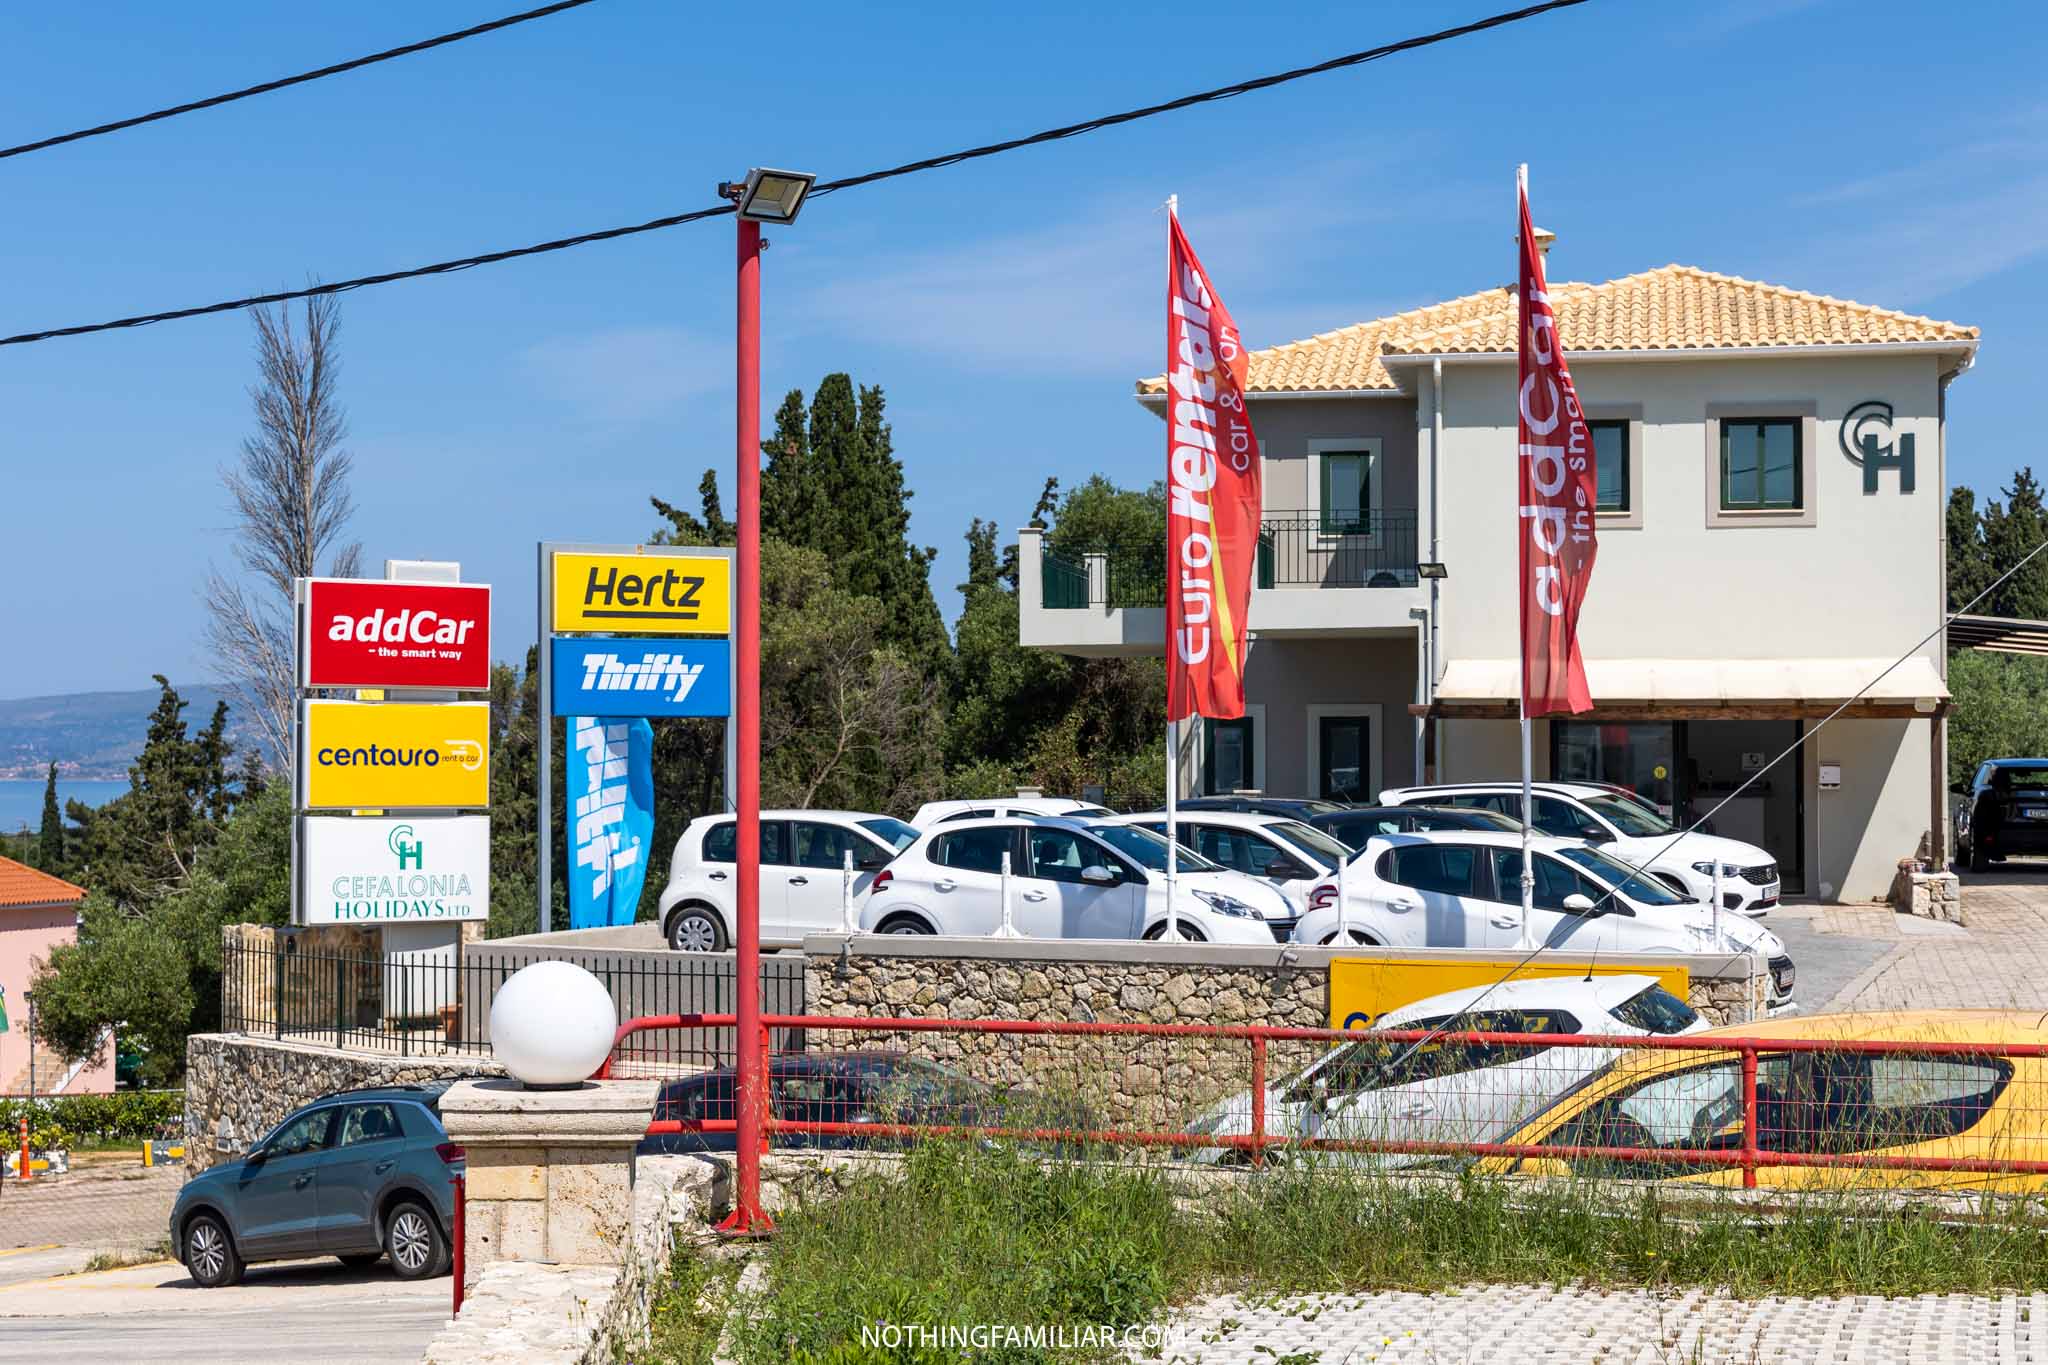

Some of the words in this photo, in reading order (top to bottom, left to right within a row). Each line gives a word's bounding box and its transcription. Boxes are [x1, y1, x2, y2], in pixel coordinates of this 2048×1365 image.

[1220, 389, 1244, 413] &
[1231, 420, 1250, 472] car
[1571, 485, 1591, 544] the
[583, 567, 705, 607] Hertz
[328, 608, 475, 645] addCar
[378, 647, 398, 657] the
[401, 648, 437, 659] smart
[439, 650, 462, 661] way
[581, 653, 705, 703] Thrifty
[318, 743, 440, 767] centauro
[332, 873, 472, 899] CEFALONIA
[335, 899, 445, 919] HOLIDAYS
[447, 905, 470, 917] LTD
